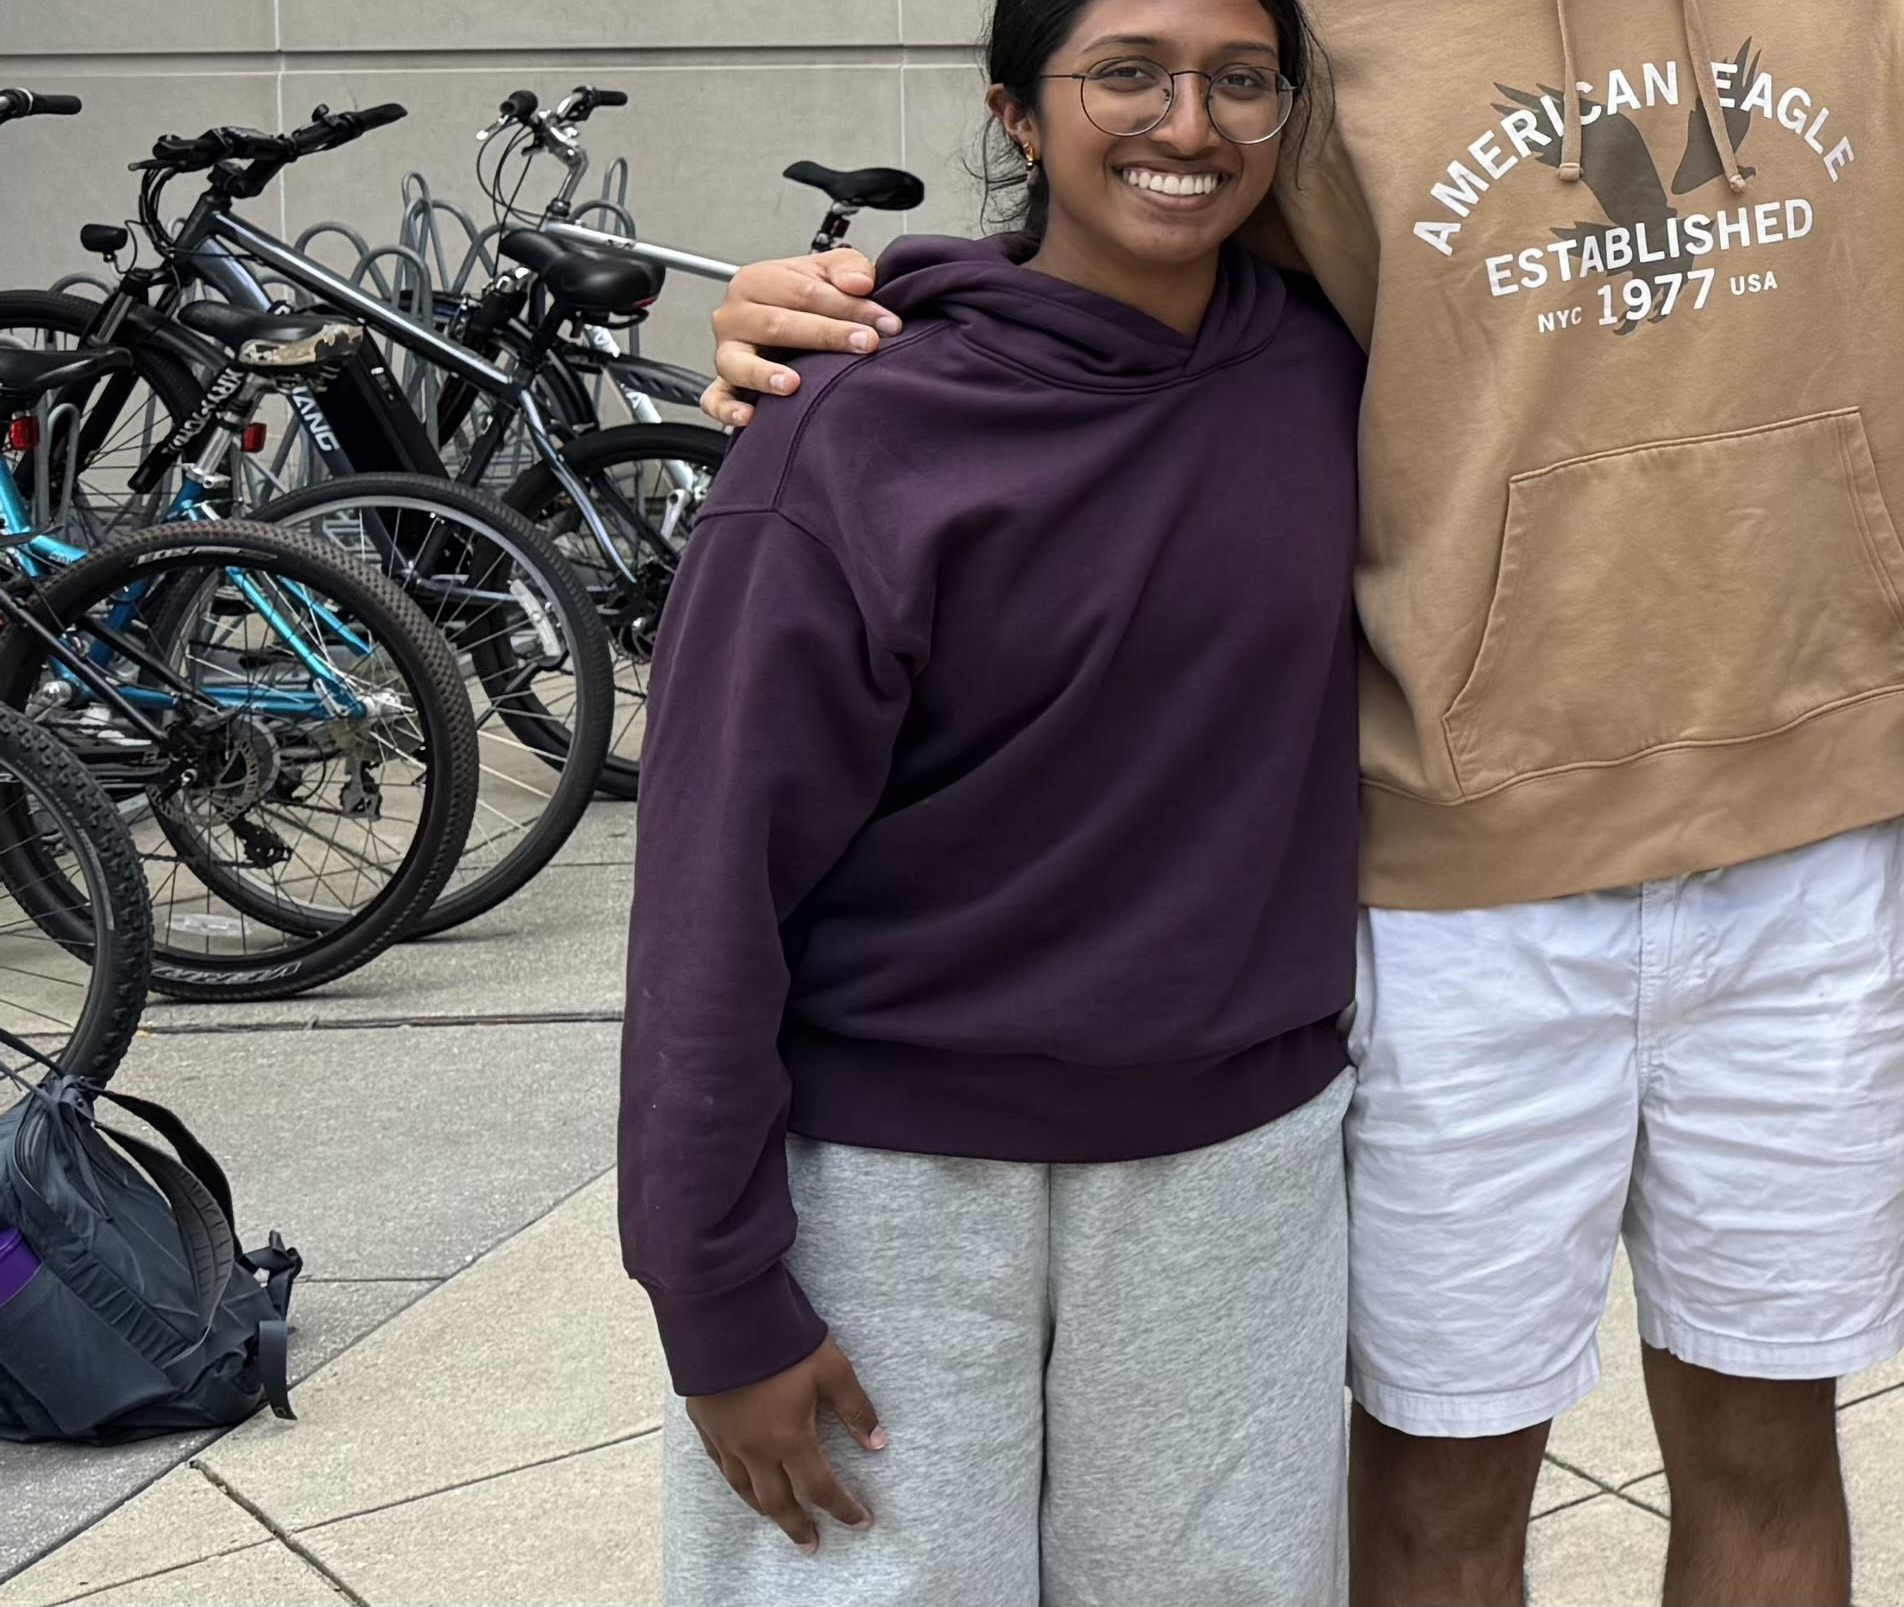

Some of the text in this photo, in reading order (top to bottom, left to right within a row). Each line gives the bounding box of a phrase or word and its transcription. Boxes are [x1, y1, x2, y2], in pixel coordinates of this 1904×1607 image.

[1413, 60, 1855, 257] AMERICAN EAGLE
[1485, 197, 1814, 297] ESTABLISHED
[1537, 268, 1779, 333] NYC 1977 USA
